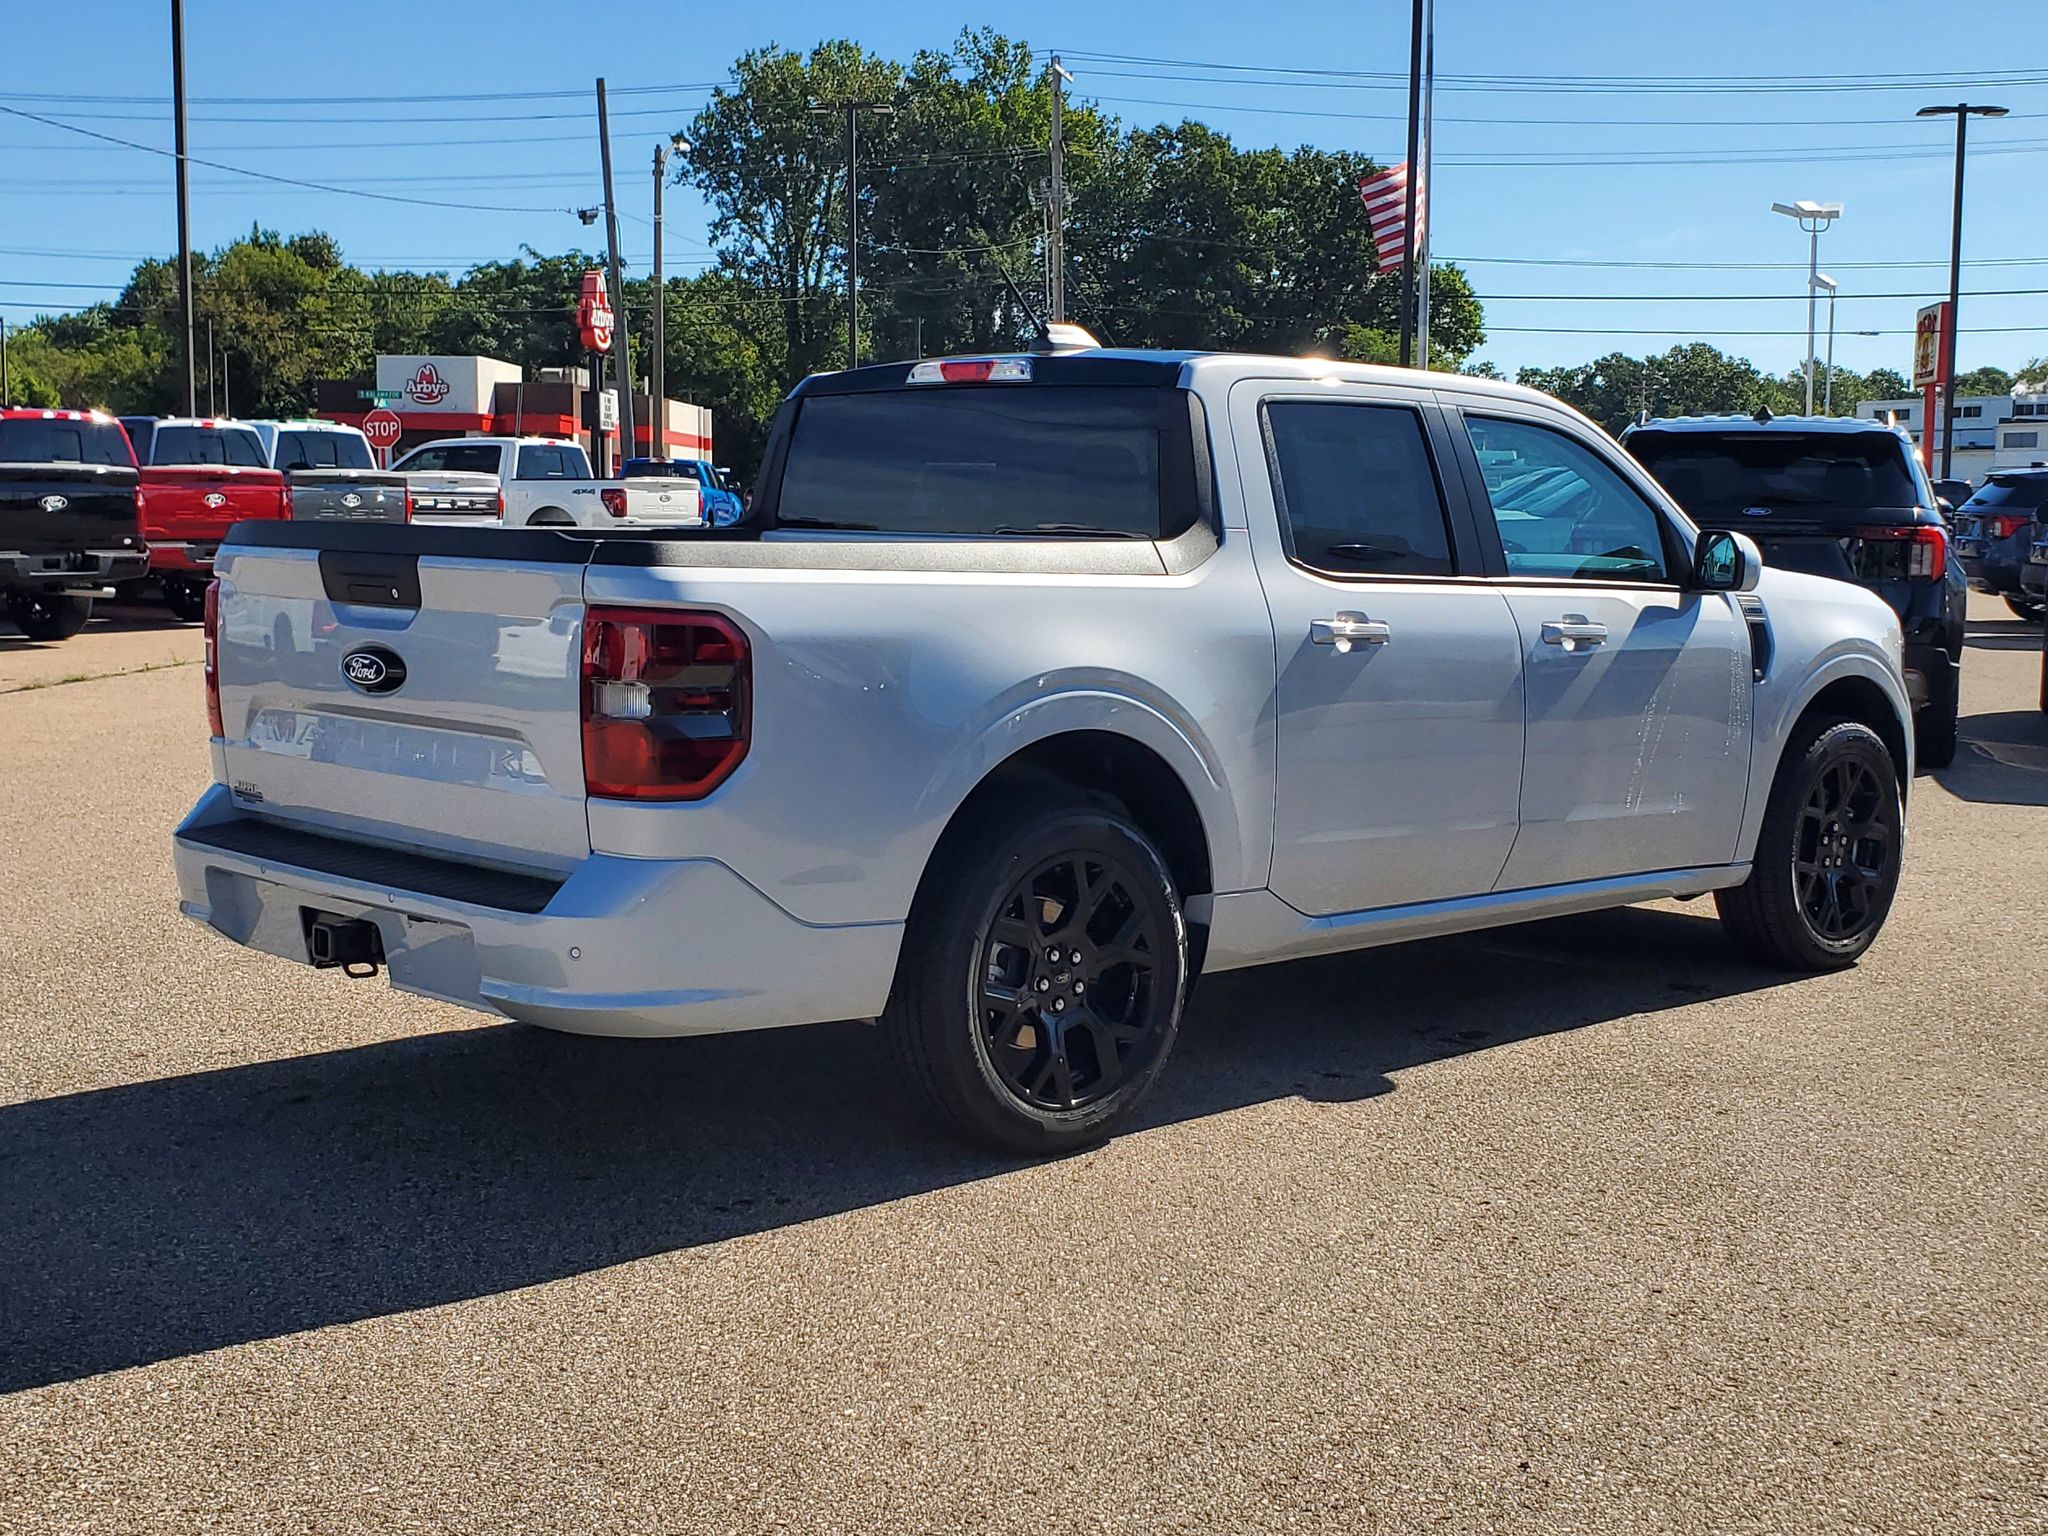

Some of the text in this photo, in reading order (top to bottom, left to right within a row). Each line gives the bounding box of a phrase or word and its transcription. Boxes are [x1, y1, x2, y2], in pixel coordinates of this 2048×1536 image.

[405, 380, 448, 396] Arby's
[366, 421, 398, 437] STOP
[350, 657, 377, 680] Ford
[263, 712, 524, 779] MAICK
